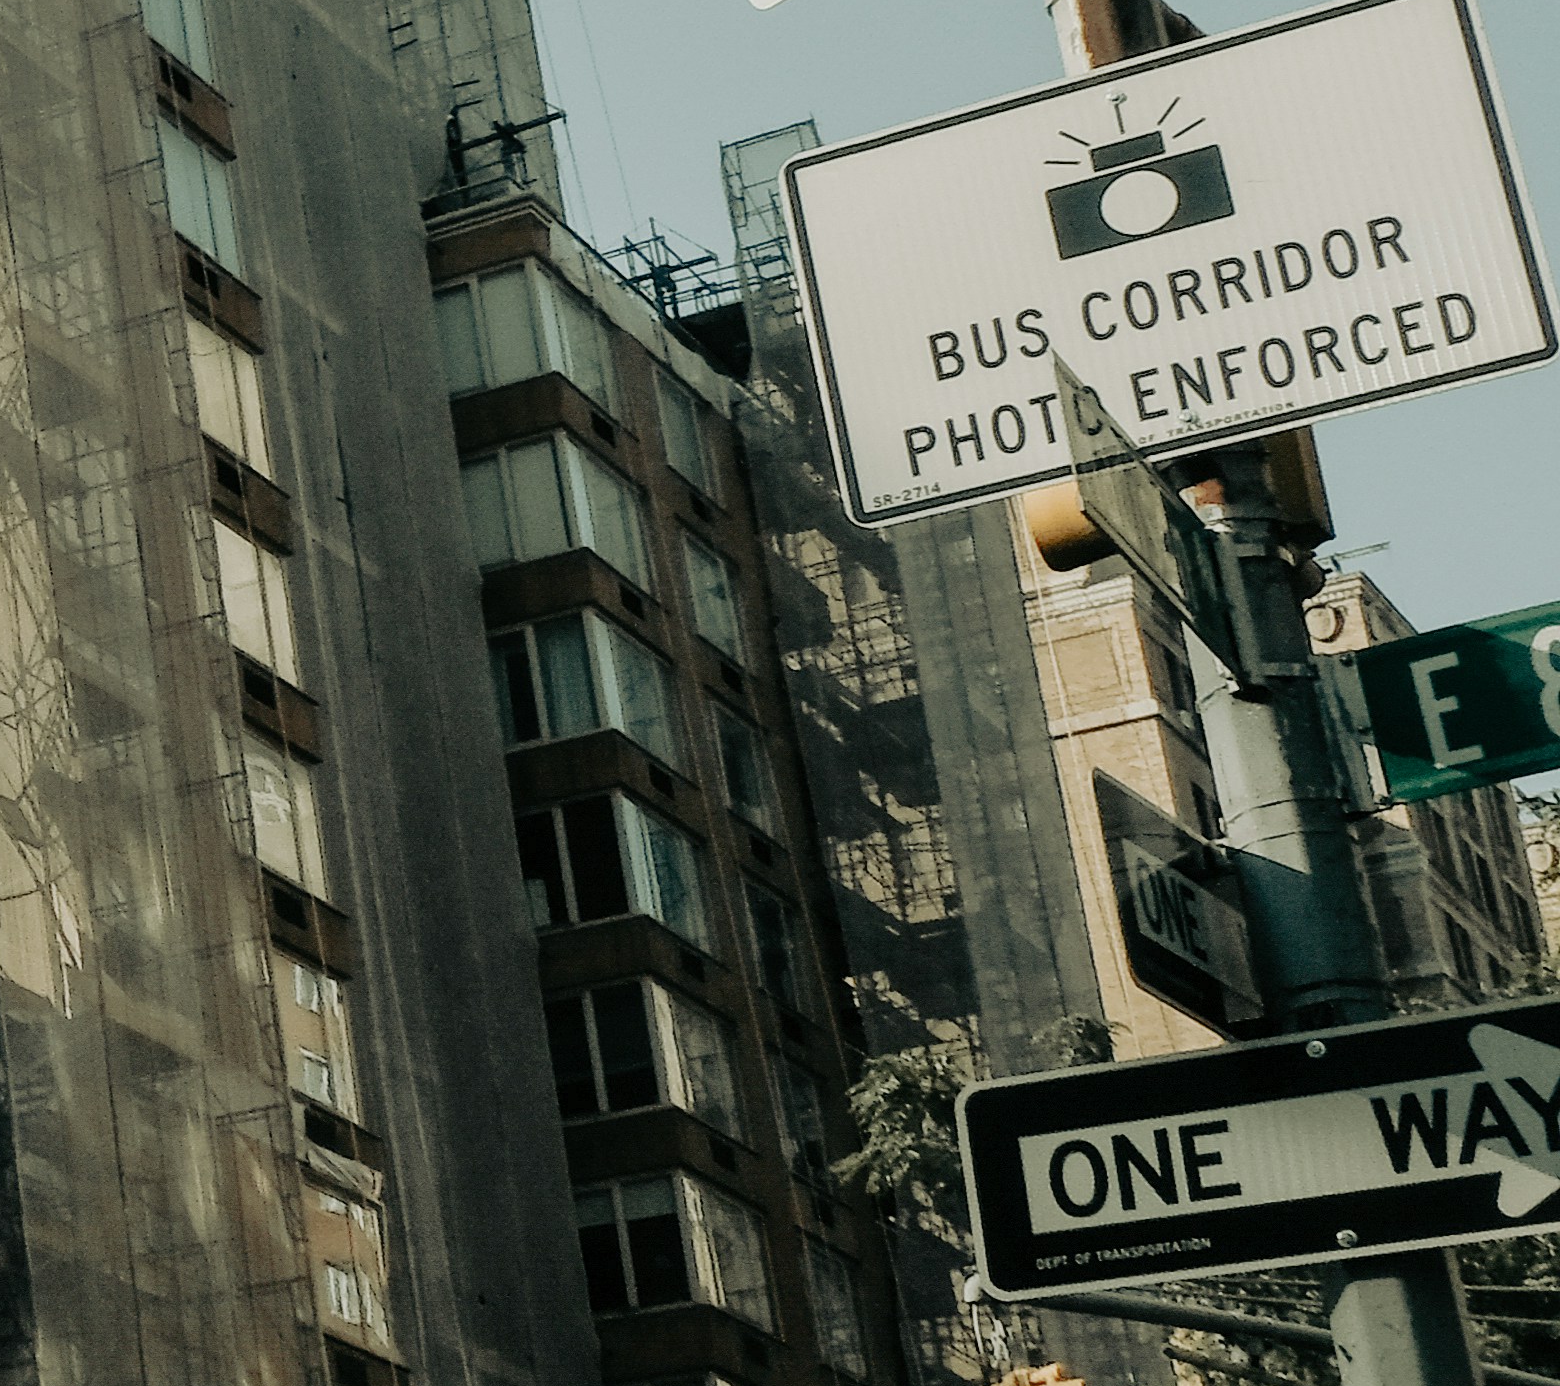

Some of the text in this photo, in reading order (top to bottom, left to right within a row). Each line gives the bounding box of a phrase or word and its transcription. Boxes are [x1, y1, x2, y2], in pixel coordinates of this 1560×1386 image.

[928, 216, 1411, 382] BUS CORRIDOR
[1130, 292, 1477, 421] ENFORCED
[873, 482, 941, 508] SR-2714
[1409, 651, 1485, 769] E
[1136, 857, 1208, 962] ONE
[1048, 1076, 1560, 1219] ONE WAY
